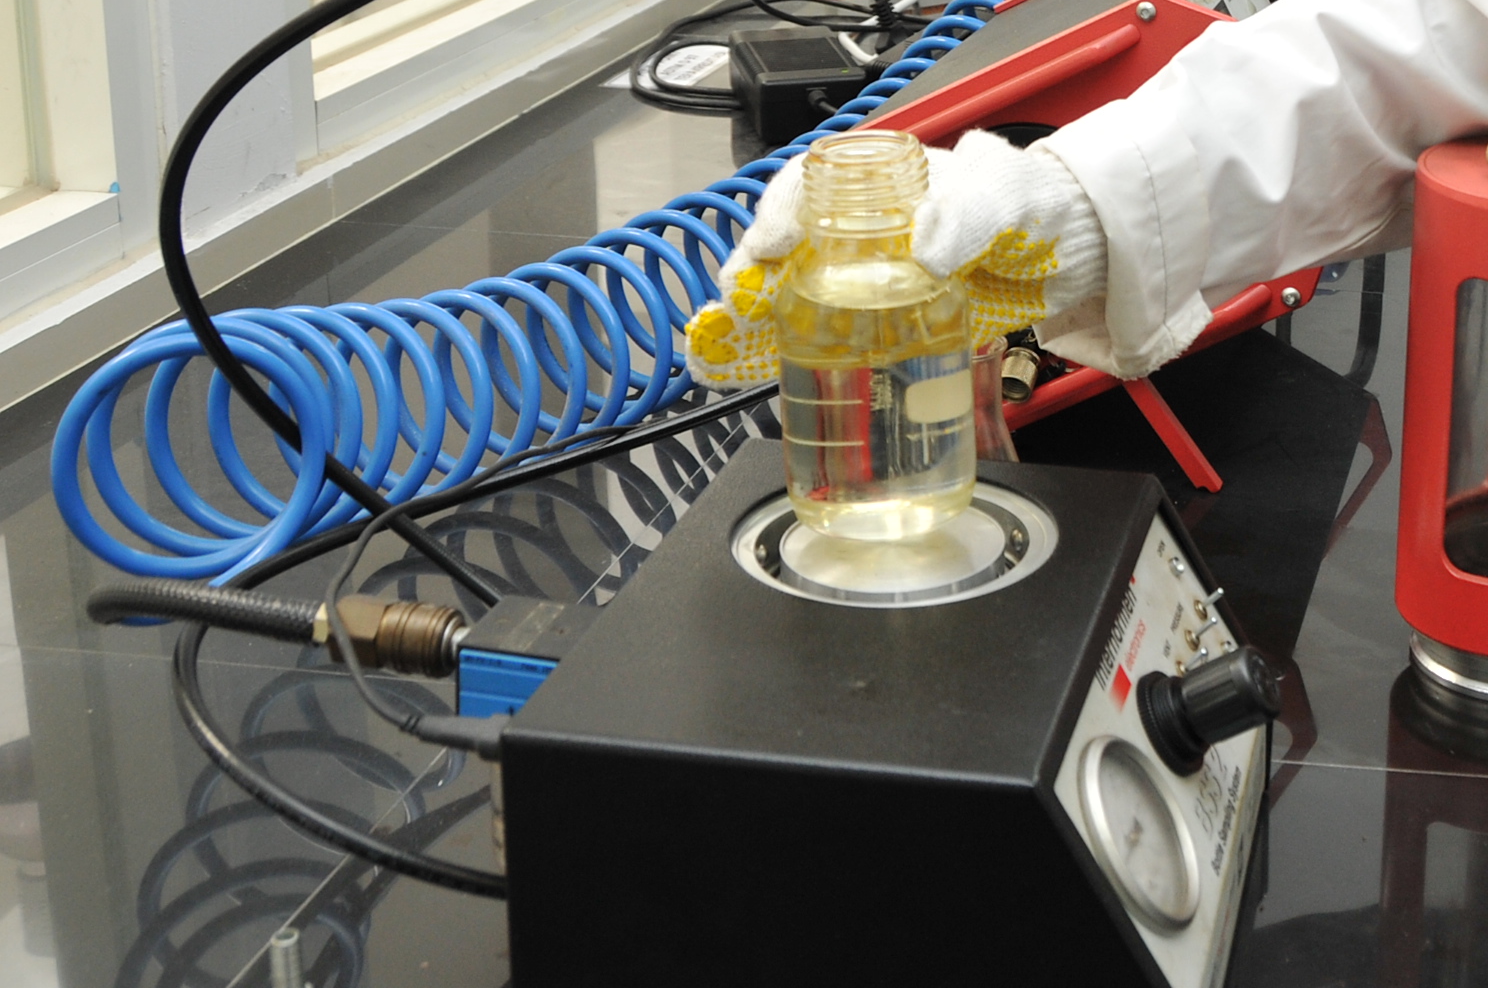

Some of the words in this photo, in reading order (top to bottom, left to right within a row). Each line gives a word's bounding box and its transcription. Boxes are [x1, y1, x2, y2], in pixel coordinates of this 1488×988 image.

[1170, 601, 1185, 634] PRESSURE
[1124, 618, 1147, 673] electronics
[1227, 764, 1242, 803] System
